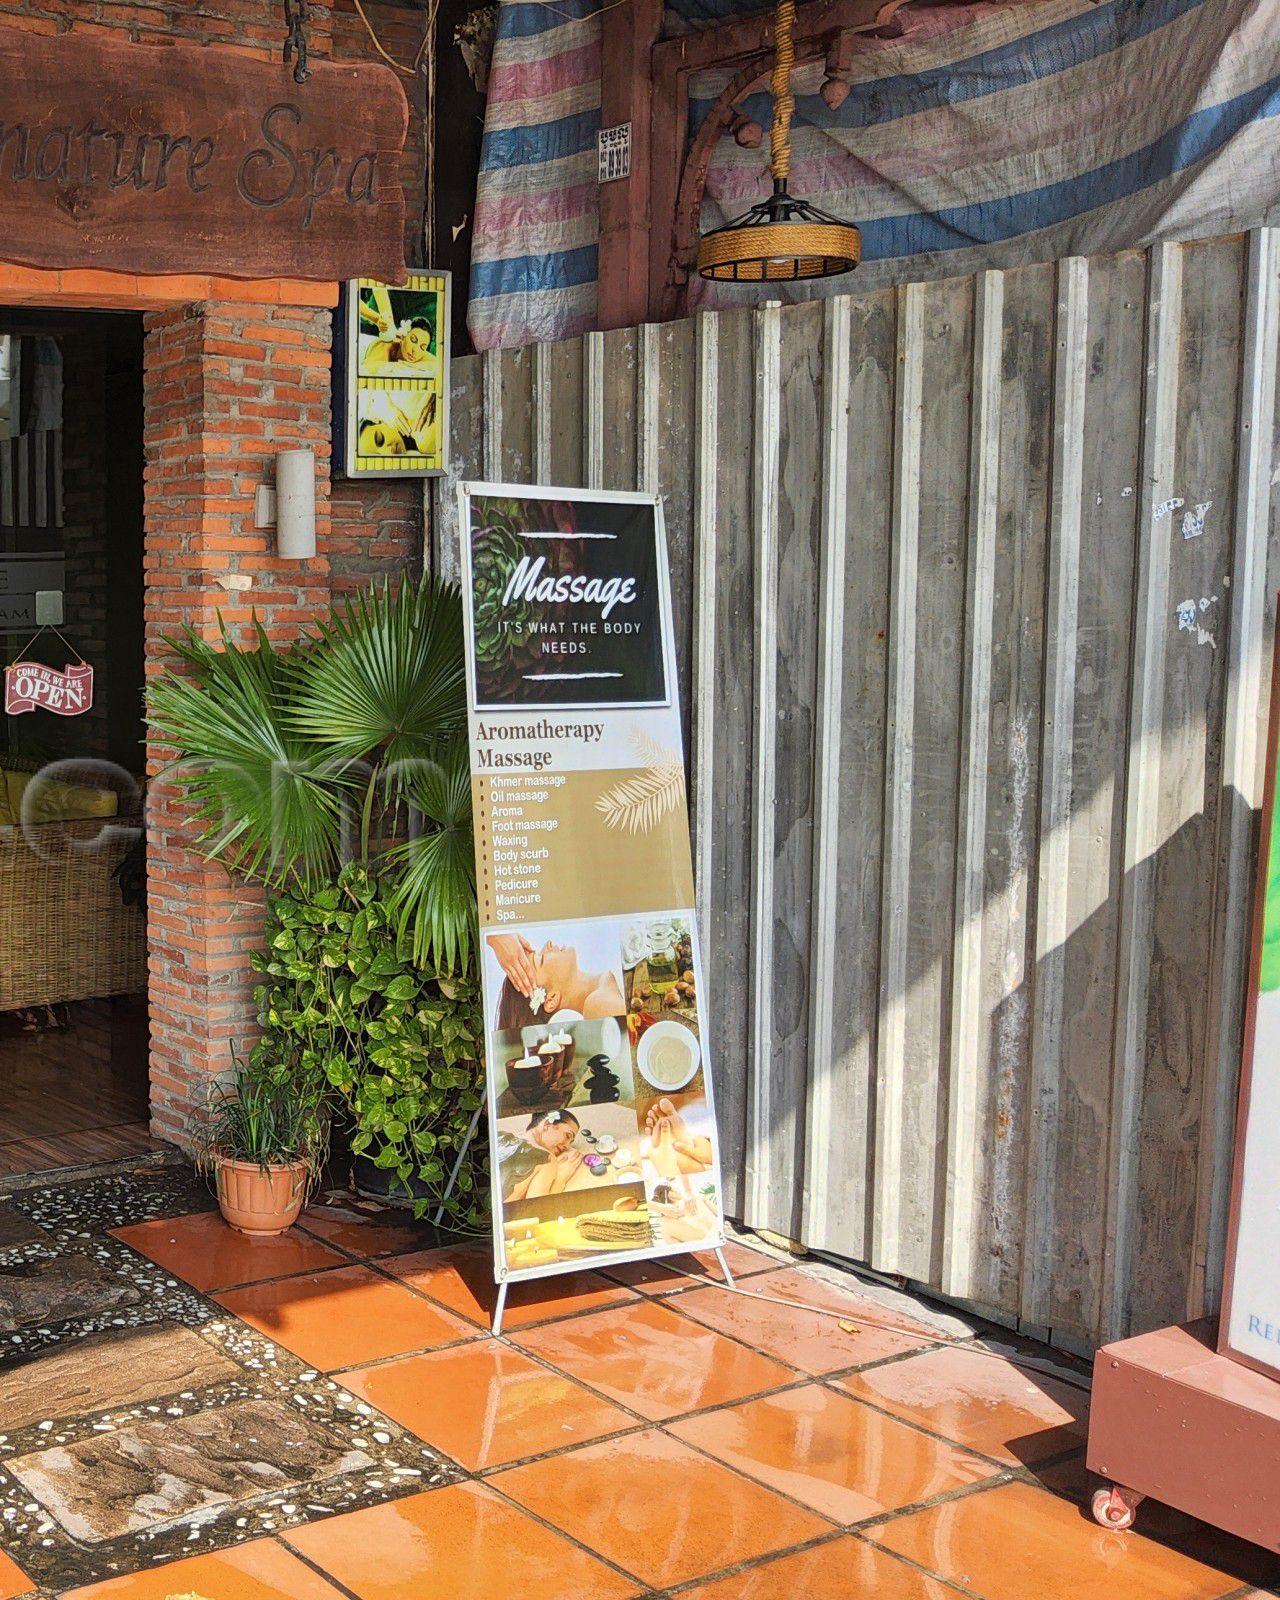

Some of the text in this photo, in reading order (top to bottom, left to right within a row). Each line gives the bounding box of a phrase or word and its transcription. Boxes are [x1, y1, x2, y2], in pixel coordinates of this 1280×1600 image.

[236, 103, 383, 230] Spa
[502, 556, 637, 620] Massage
[498, 621, 642, 634] IT'S WHAT THE BODY
[16, 667, 40, 677] COME
[52, 675, 64, 687] WE
[66, 679, 83, 689] ARE
[15, 676, 84, 709] OPEN
[476, 719, 605, 743] Aromatherapy
[477, 748, 553, 771] Massage
[490, 775, 566, 788] Khmer massage
[490, 790, 549, 803] Oil massage
[491, 805, 523, 817] Aroma
[491, 819, 558, 832] Foot massage
[492, 834, 528, 848] Waxing
[493, 847, 549, 863] Body scurb
[494, 863, 542, 876] Hot stone
[495, 879, 539, 891] Pedicure
[495, 893, 542, 906] Manicure
[496, 909, 525, 923] Spa...
